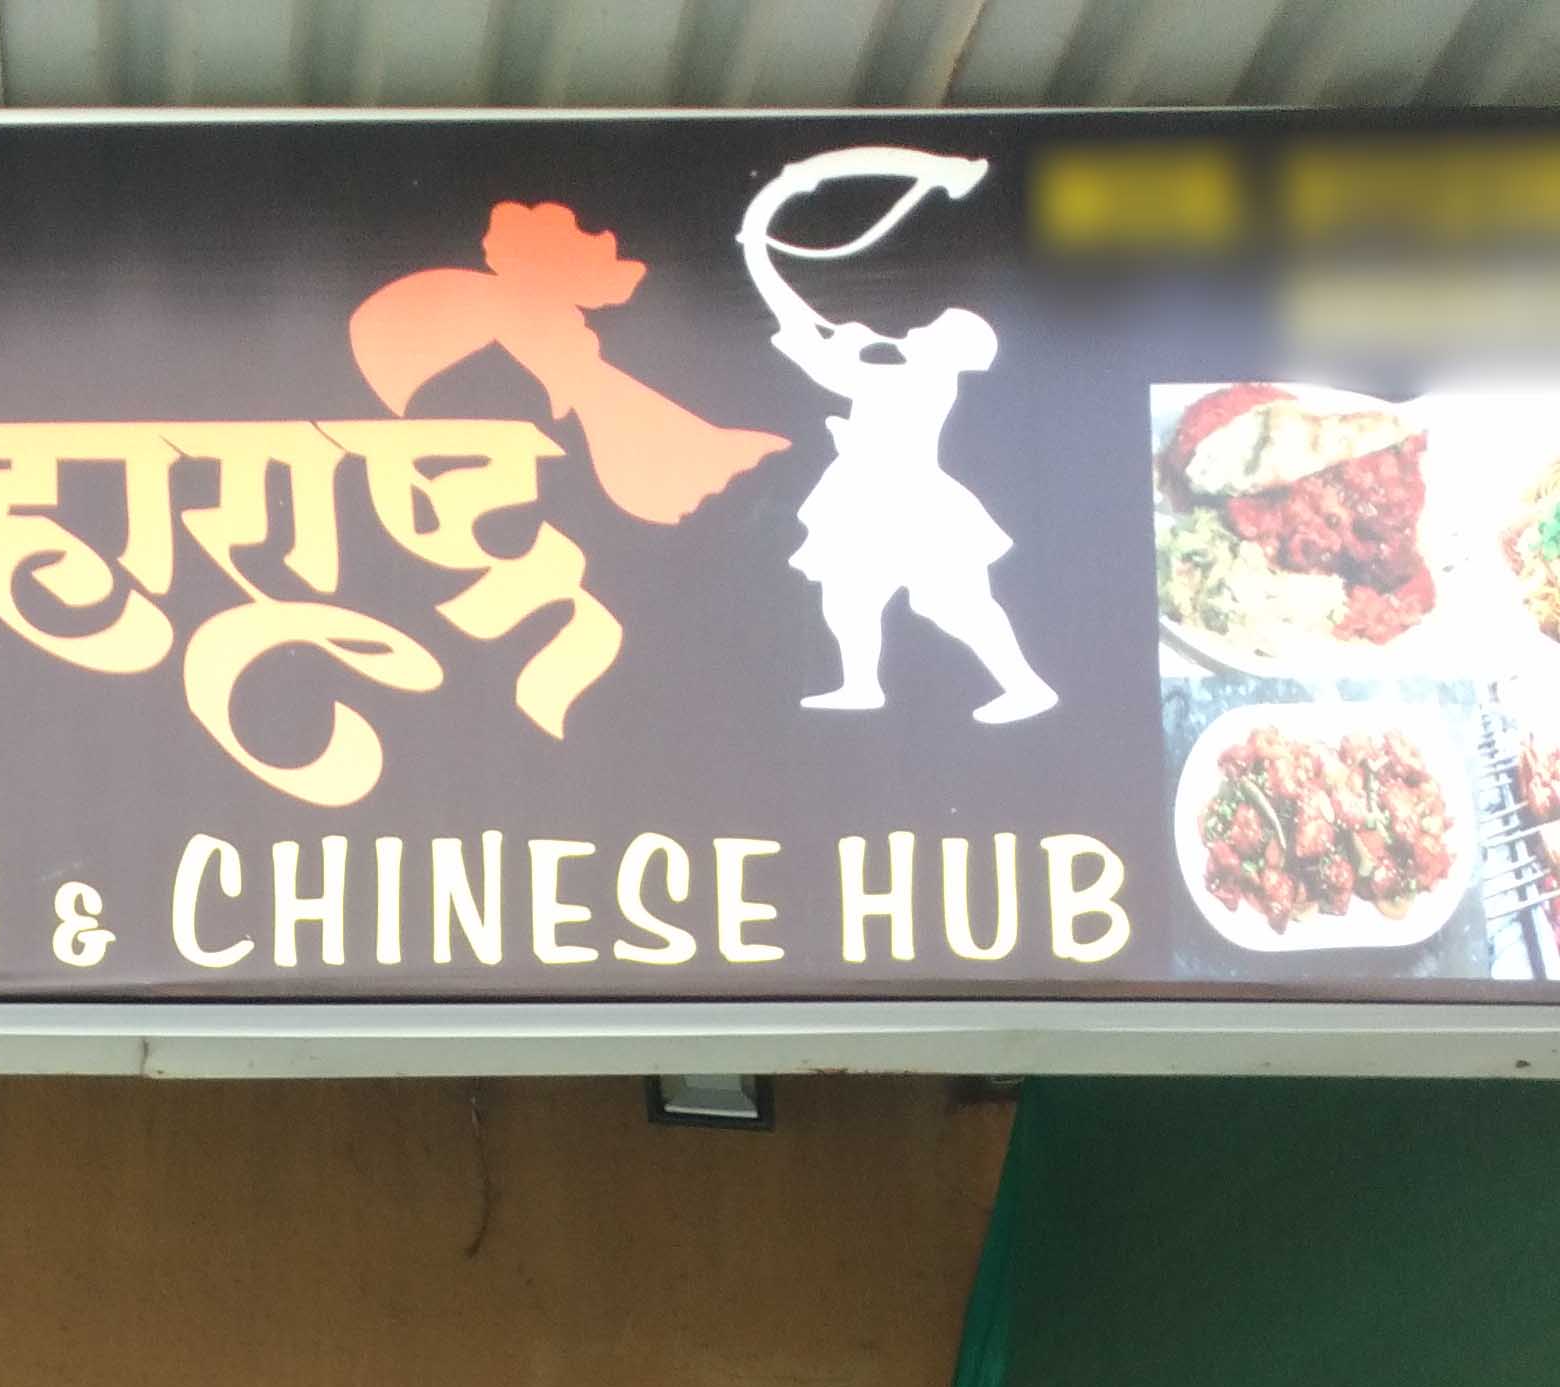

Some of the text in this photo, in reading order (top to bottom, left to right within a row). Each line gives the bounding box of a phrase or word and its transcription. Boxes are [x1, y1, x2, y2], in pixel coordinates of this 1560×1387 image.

[51, 880, 118, 968] &
[171, 829, 786, 968] CHINESE
[837, 830, 1132, 964] HUB
